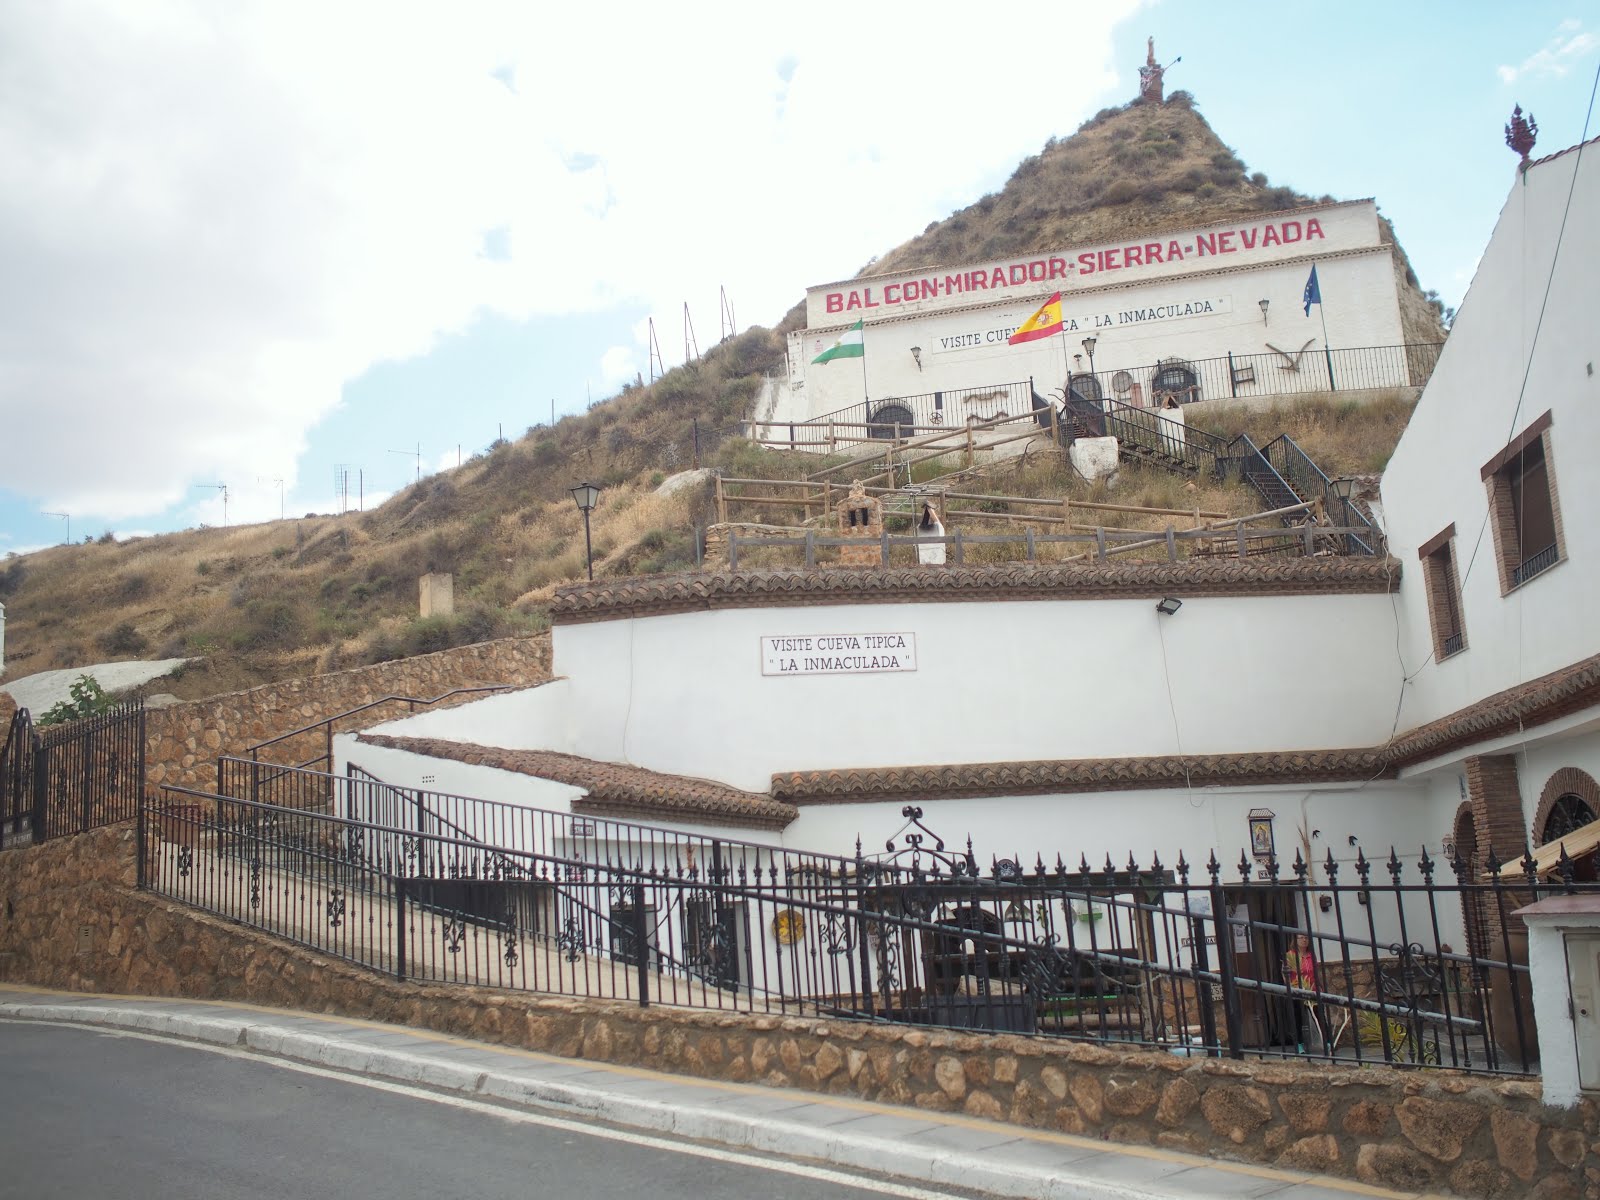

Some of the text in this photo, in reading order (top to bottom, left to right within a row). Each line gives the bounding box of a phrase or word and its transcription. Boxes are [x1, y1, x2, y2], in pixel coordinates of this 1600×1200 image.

[941, 333, 981, 349] VISITE
[771, 636, 906, 651] VISITE CUEVA TIPICA
